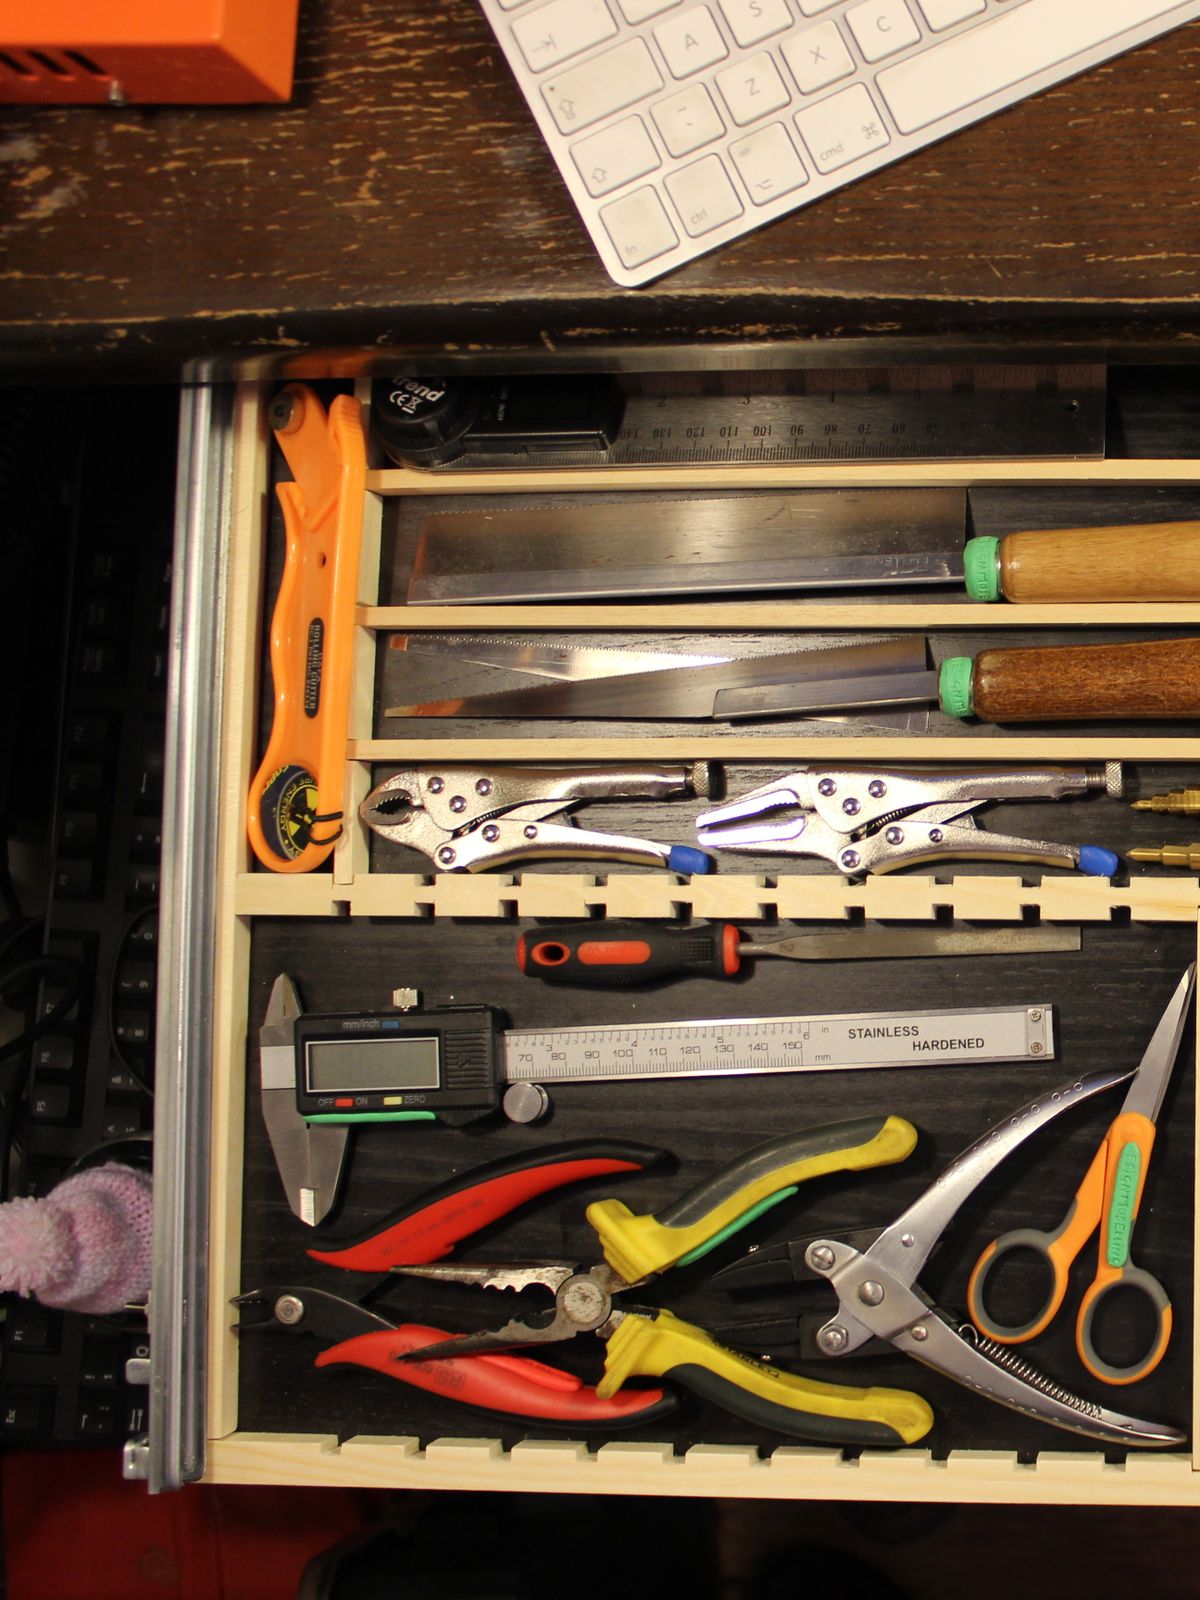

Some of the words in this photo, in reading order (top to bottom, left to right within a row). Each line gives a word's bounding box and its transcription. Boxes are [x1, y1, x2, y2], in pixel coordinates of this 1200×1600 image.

[683, 33, 699, 51] A
[748, 1, 763, 18] S
[743, 78, 762, 97] Z
[808, 46, 827, 64] X
[875, 15, 891, 34] C
[819, 142, 844, 162] cmd
[689, 208, 708, 224] ctrl
[652, 428, 672, 439] 130
[686, 427, 705, 438] 120
[719, 426, 739, 438] 110
[753, 425, 773, 437] 100
[790, 424, 804, 436] 90
[824, 423, 838, 435] 80
[858, 423, 872, 435] 70
[848, 1024, 920, 1040] STAINLESS
[912, 1037, 985, 1052] HARDENED
[518, 1053, 533, 1062] 70
[551, 1052, 566, 1060] 80
[585, 1051, 600, 1059] 90
[613, 1049, 634, 1057] 100
[649, 1048, 667, 1056] 110
[680, 1045, 701, 1055] 120
[714, 1044, 734, 1053] 130
[748, 1042, 768, 1051] 140
[783, 1041, 802, 1050] 150
[404, 1096, 425, 1104] ZERO
